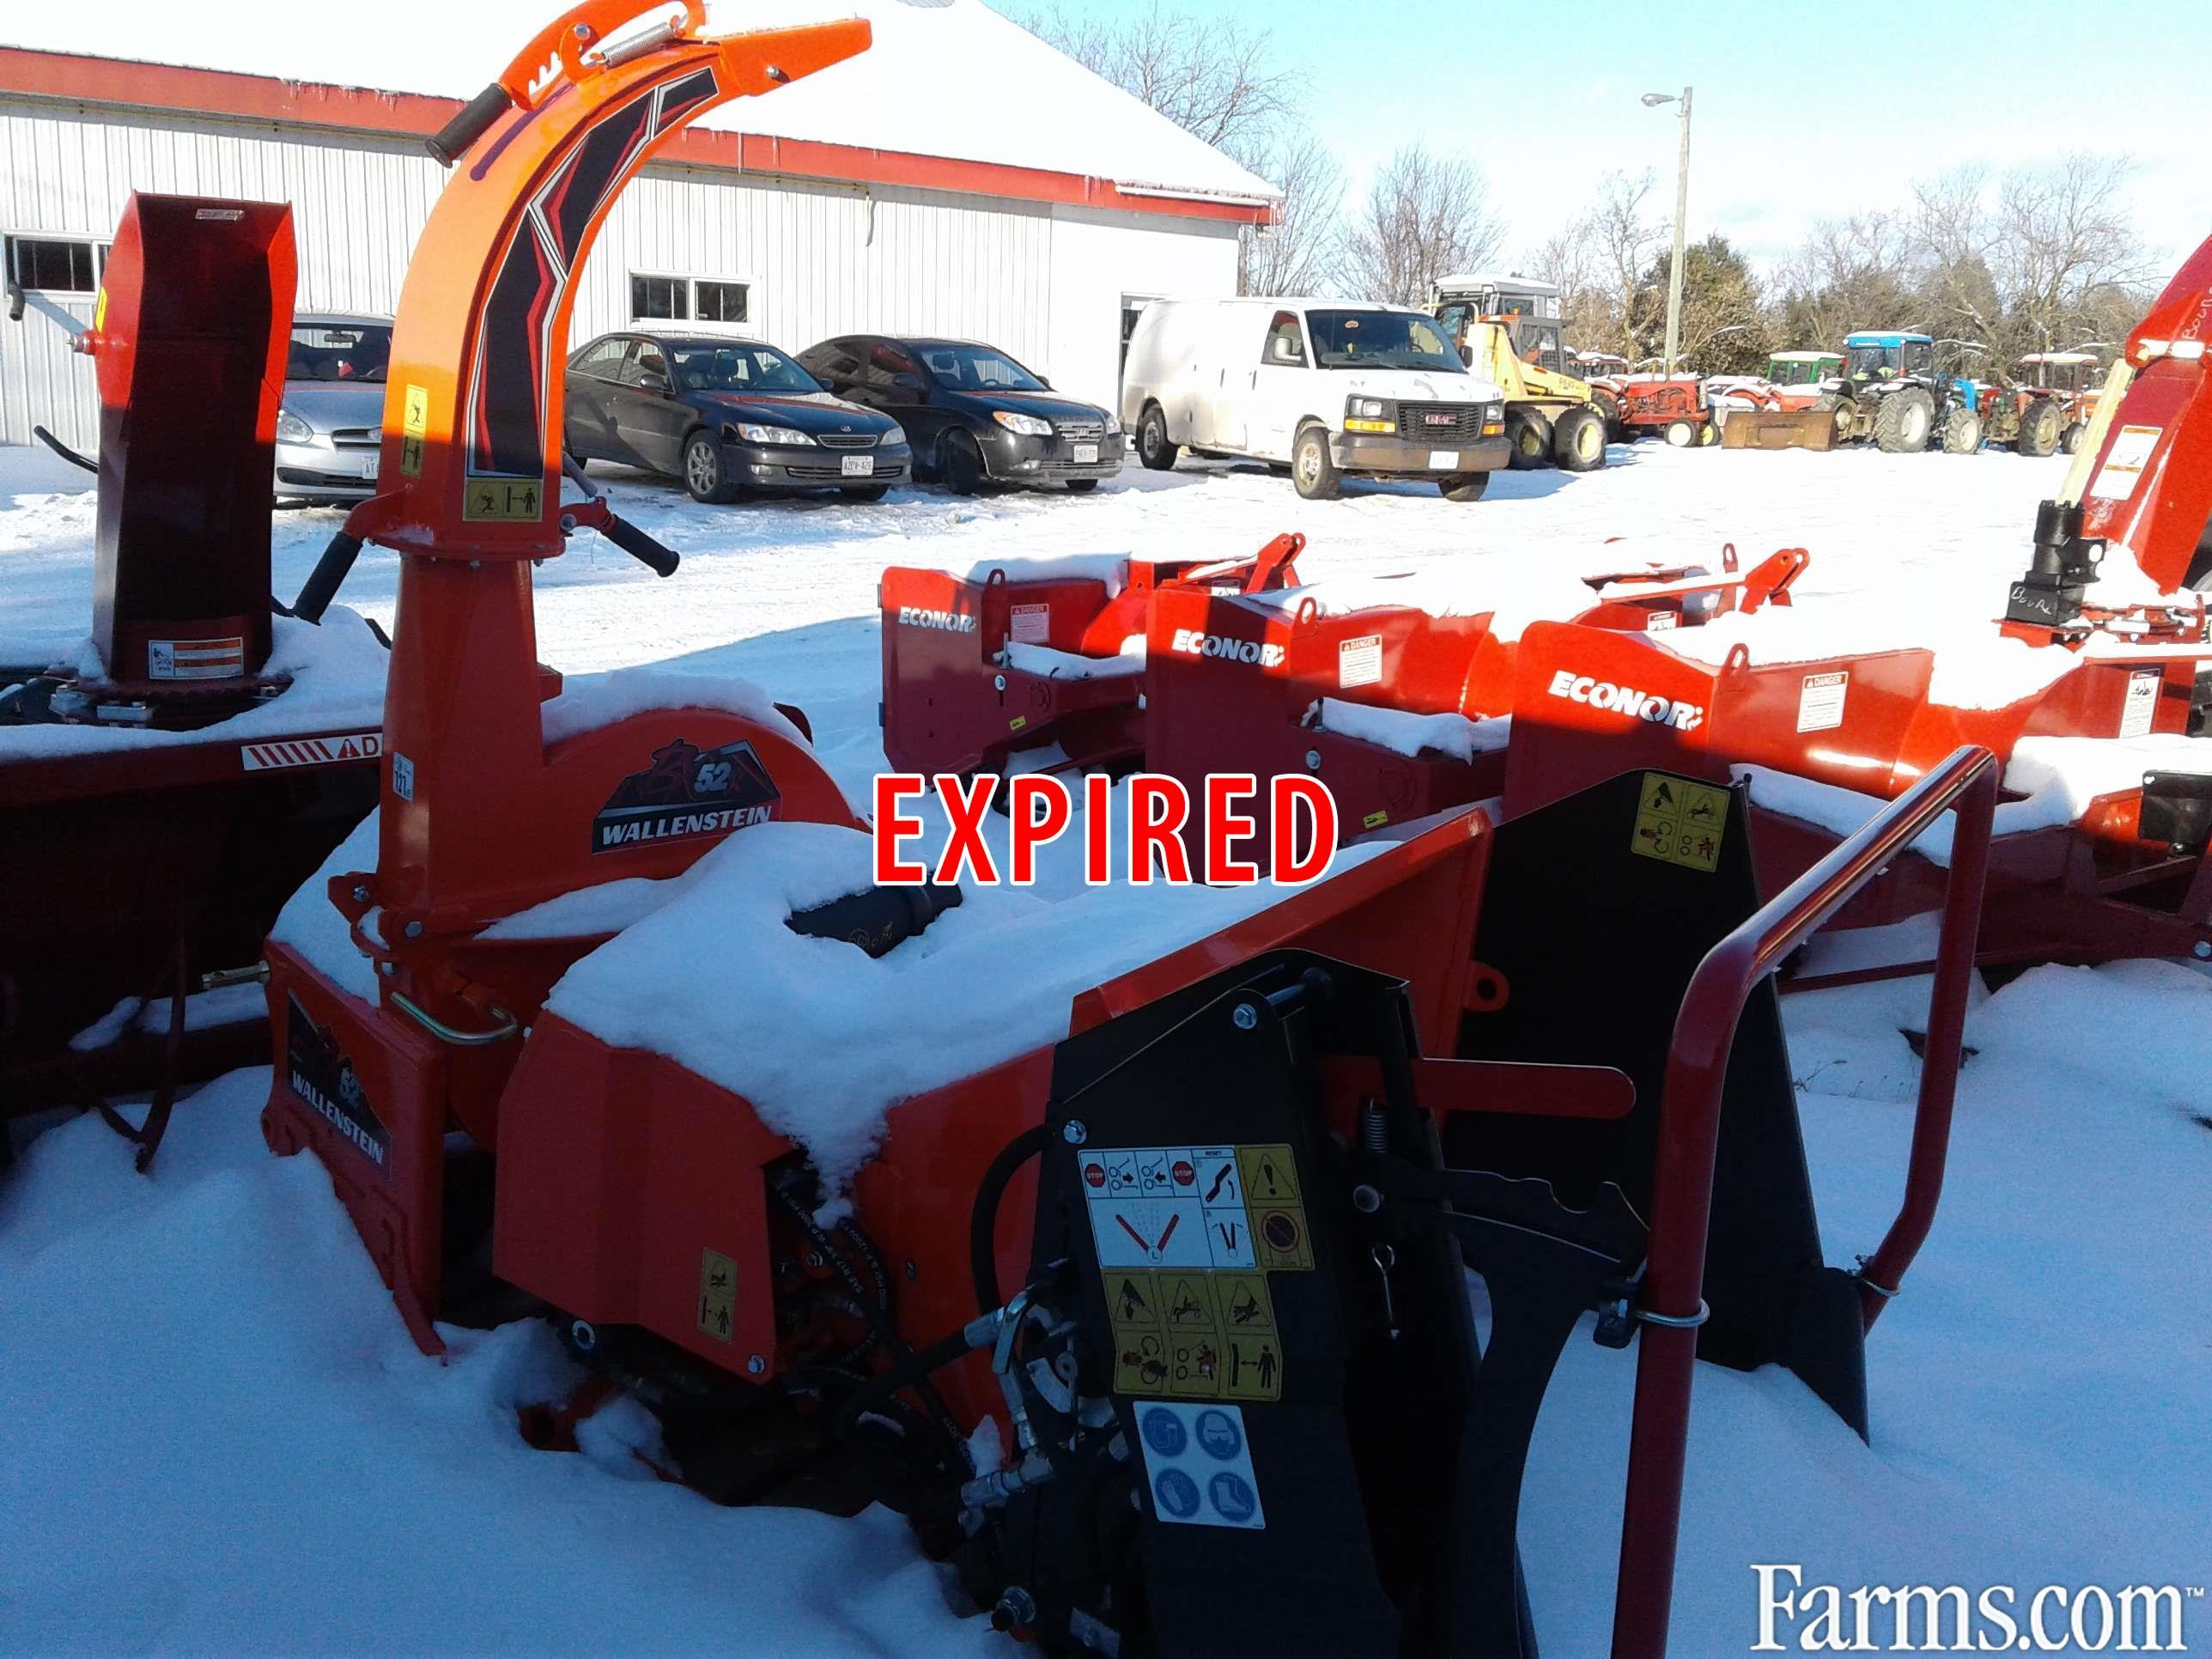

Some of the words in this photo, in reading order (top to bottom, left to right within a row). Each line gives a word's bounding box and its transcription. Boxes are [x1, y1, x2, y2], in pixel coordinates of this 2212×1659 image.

[1425, 415, 1456, 425] GMC
[694, 762, 732, 793] 52
[603, 805, 772, 845] WALLENSTEIN
[293, 1070, 385, 1164] WALLENSTEIN
